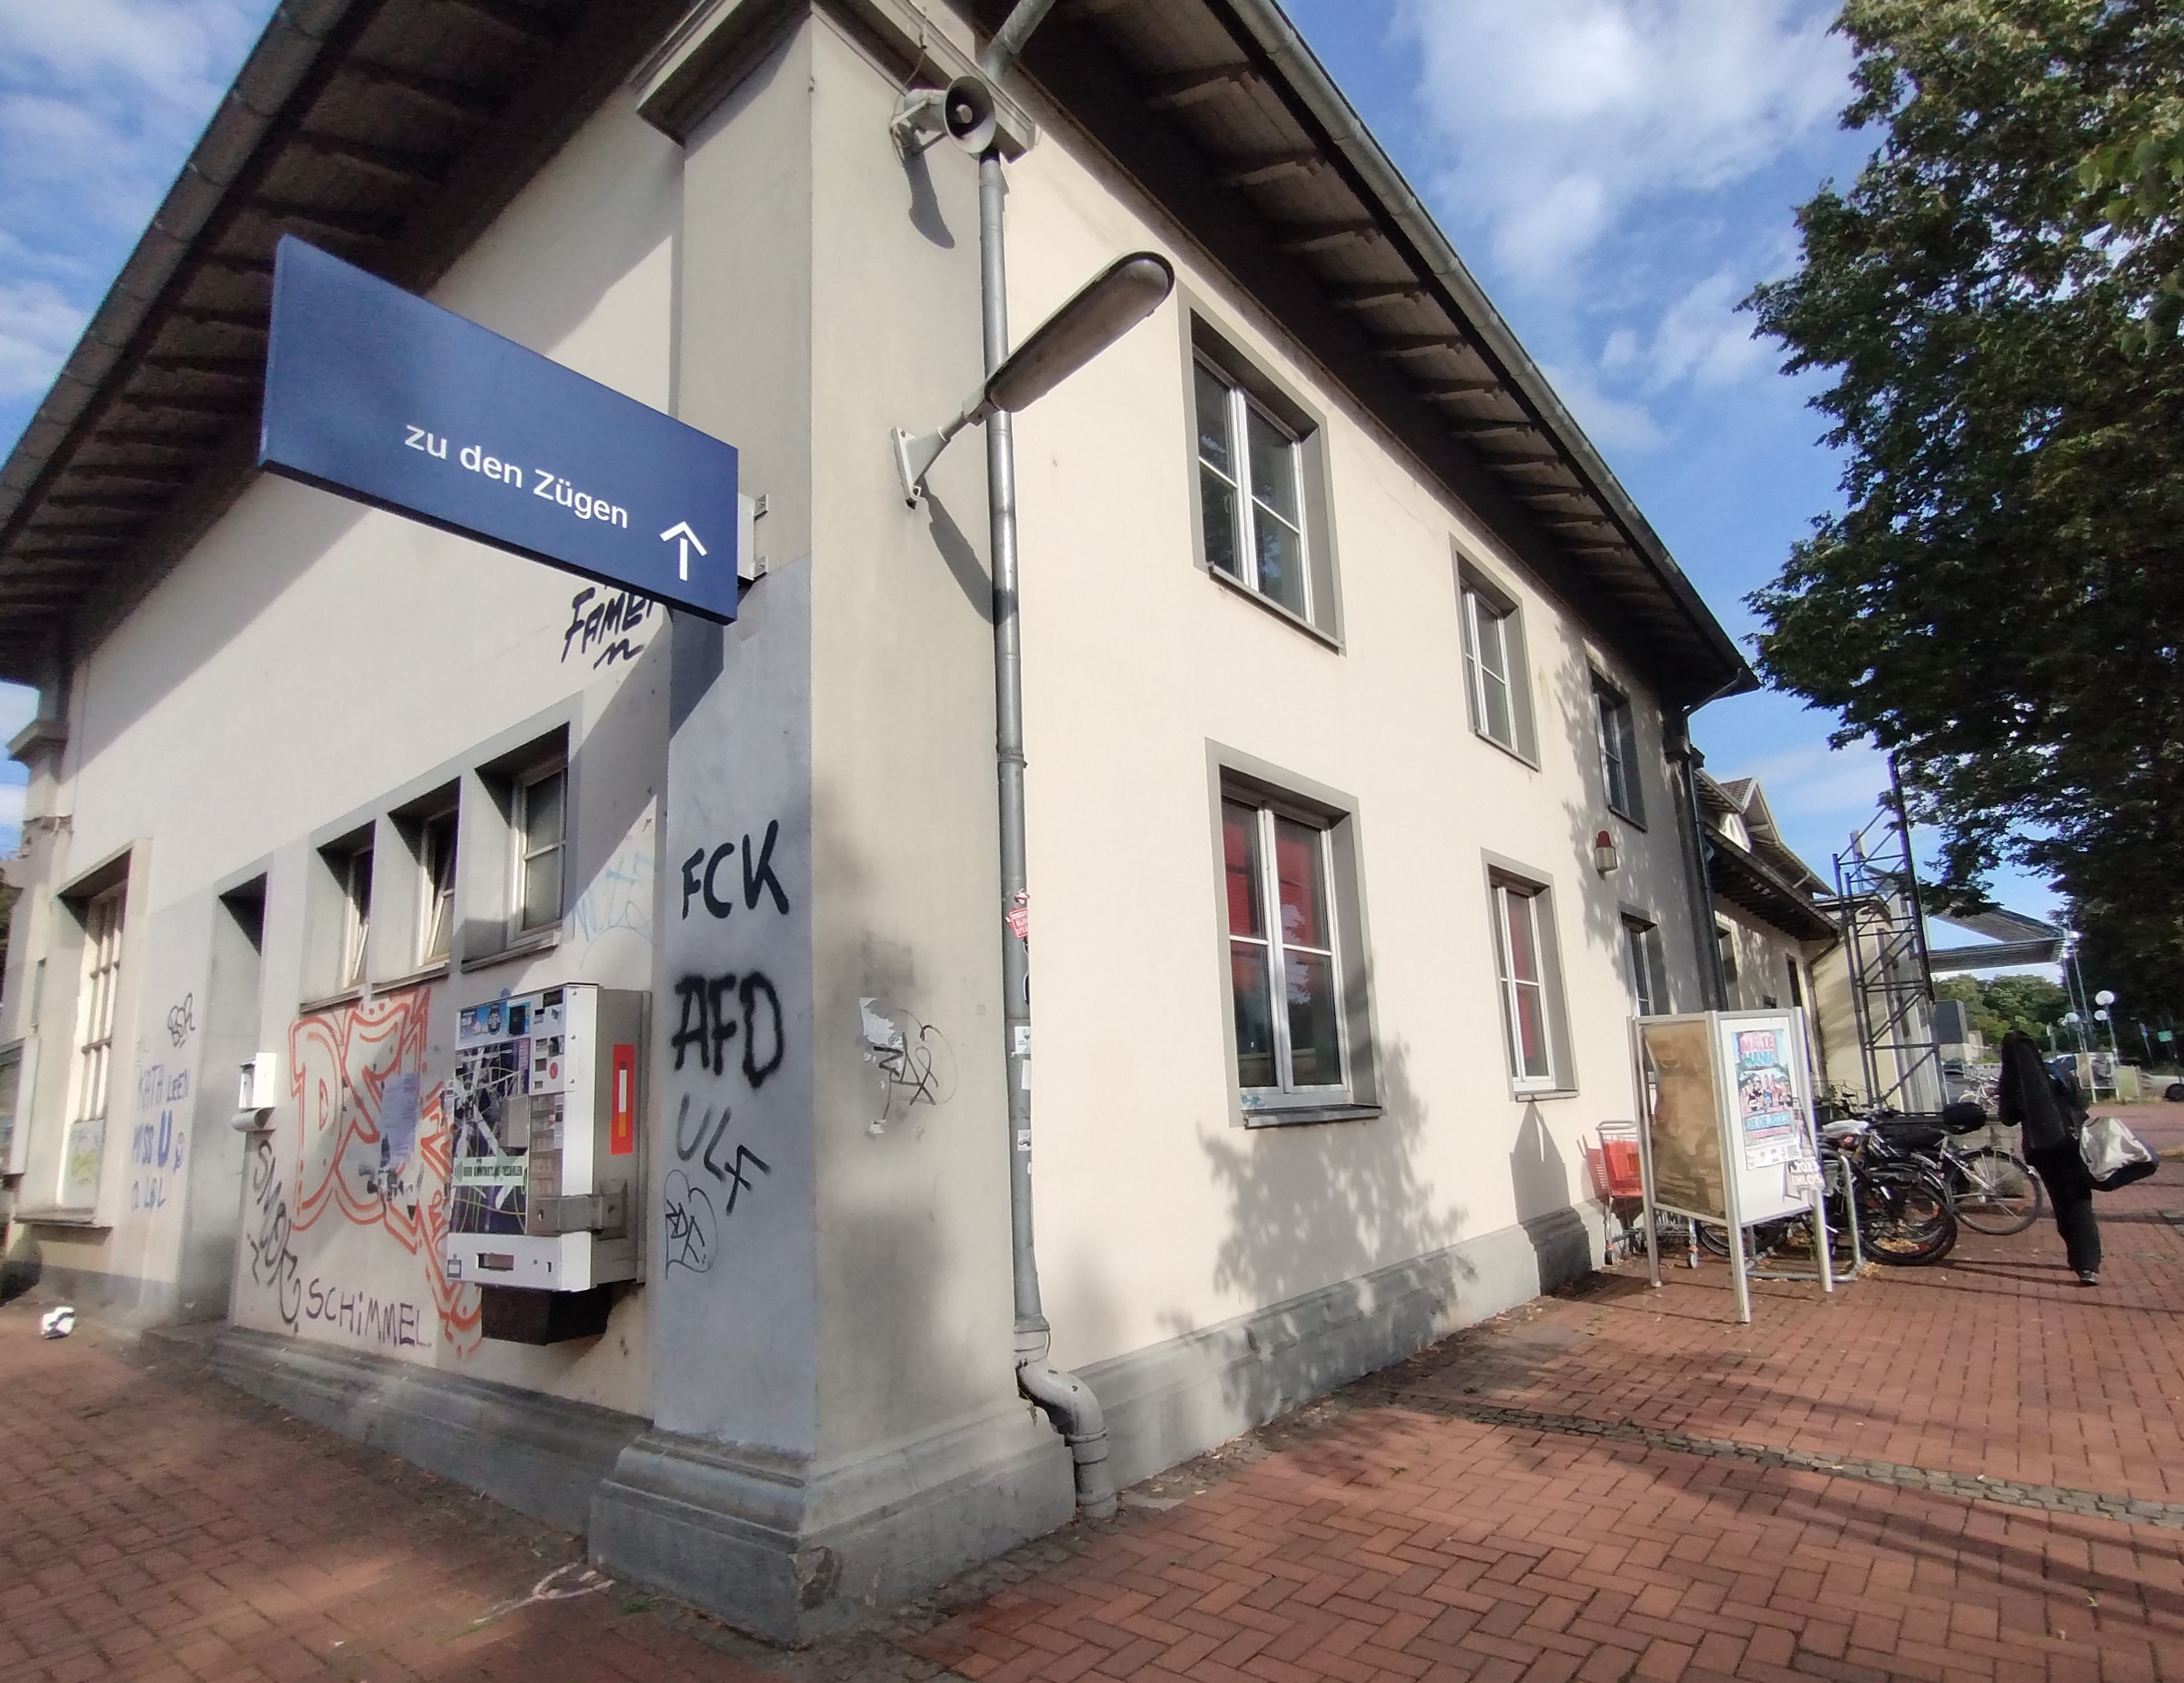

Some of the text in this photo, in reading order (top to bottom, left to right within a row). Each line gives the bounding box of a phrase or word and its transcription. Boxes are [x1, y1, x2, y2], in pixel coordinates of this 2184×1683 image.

[404, 424, 628, 529] zu den Zügen
[682, 819, 790, 920] FCK
[671, 971, 784, 1089] AFD
[158, 1110, 173, 1169] U
